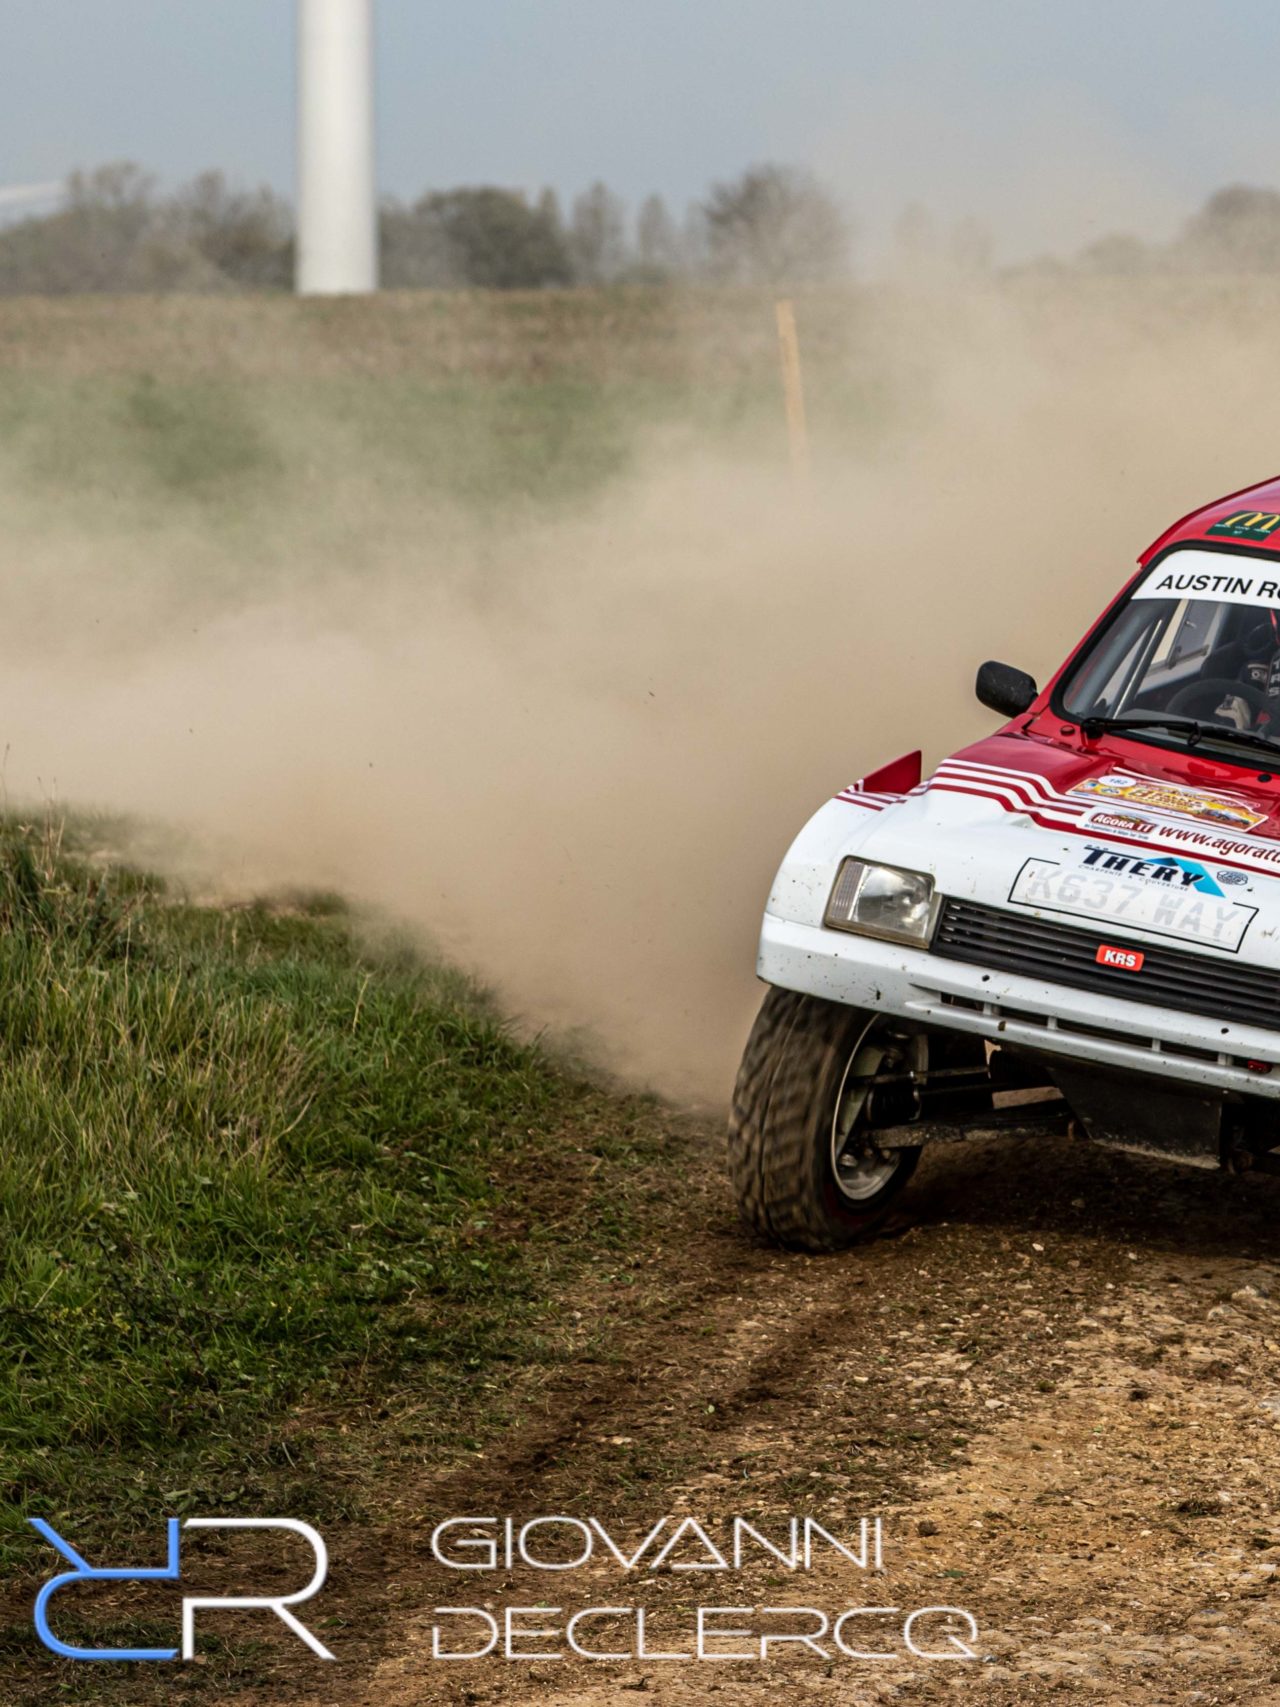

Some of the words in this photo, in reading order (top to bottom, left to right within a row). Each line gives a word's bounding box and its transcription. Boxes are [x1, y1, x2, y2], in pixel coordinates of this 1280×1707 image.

[1155, 574, 1253, 595] AUSTIN
[1093, 813, 1136, 829] AGORA
[1082, 846, 1205, 887] THERY
[1029, 866, 1144, 915] K637
[1152, 893, 1240, 941] WAY
[1103, 949, 1137, 968] KRS
